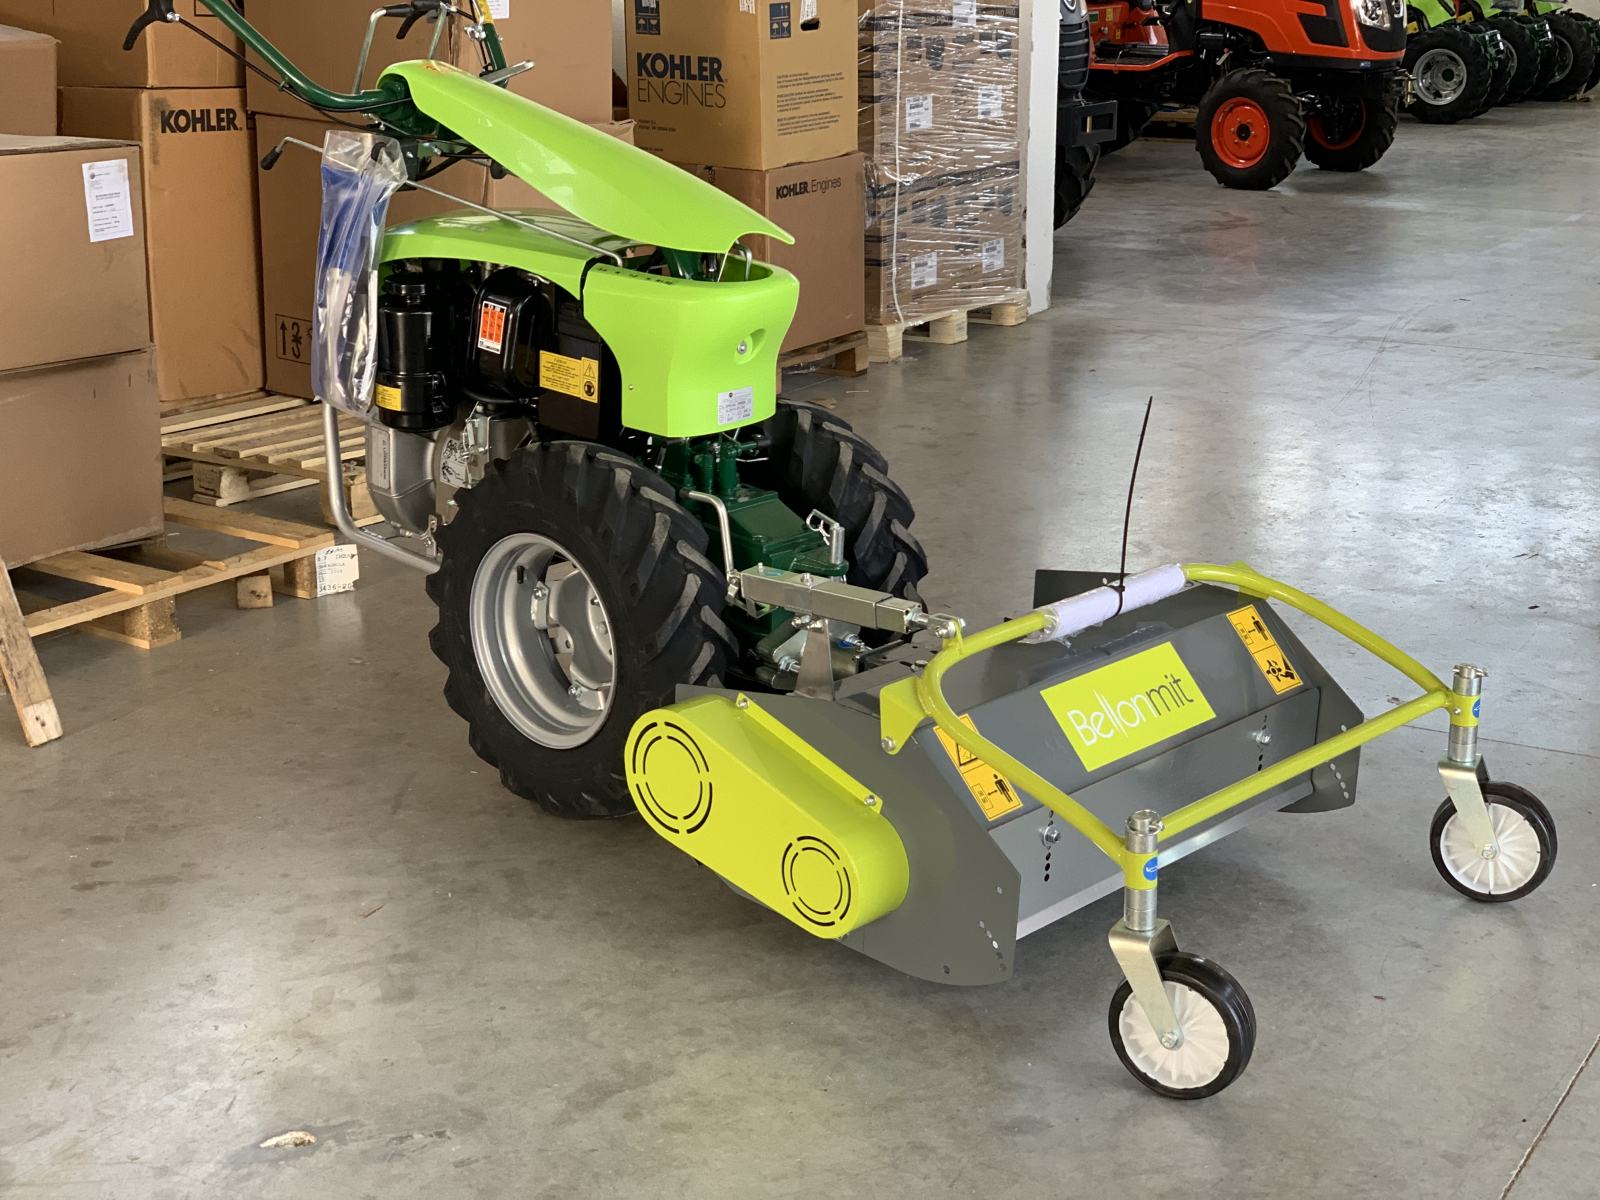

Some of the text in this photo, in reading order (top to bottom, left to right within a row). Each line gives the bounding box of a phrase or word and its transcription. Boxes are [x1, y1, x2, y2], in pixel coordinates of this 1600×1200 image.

[637, 52, 725, 82] KOHLER
[637, 79, 727, 109] ENGINES
[160, 108, 239, 133] KOHLER
[776, 177, 842, 200] KOHLER Engines
[1067, 673, 1194, 746] Bellonmit
